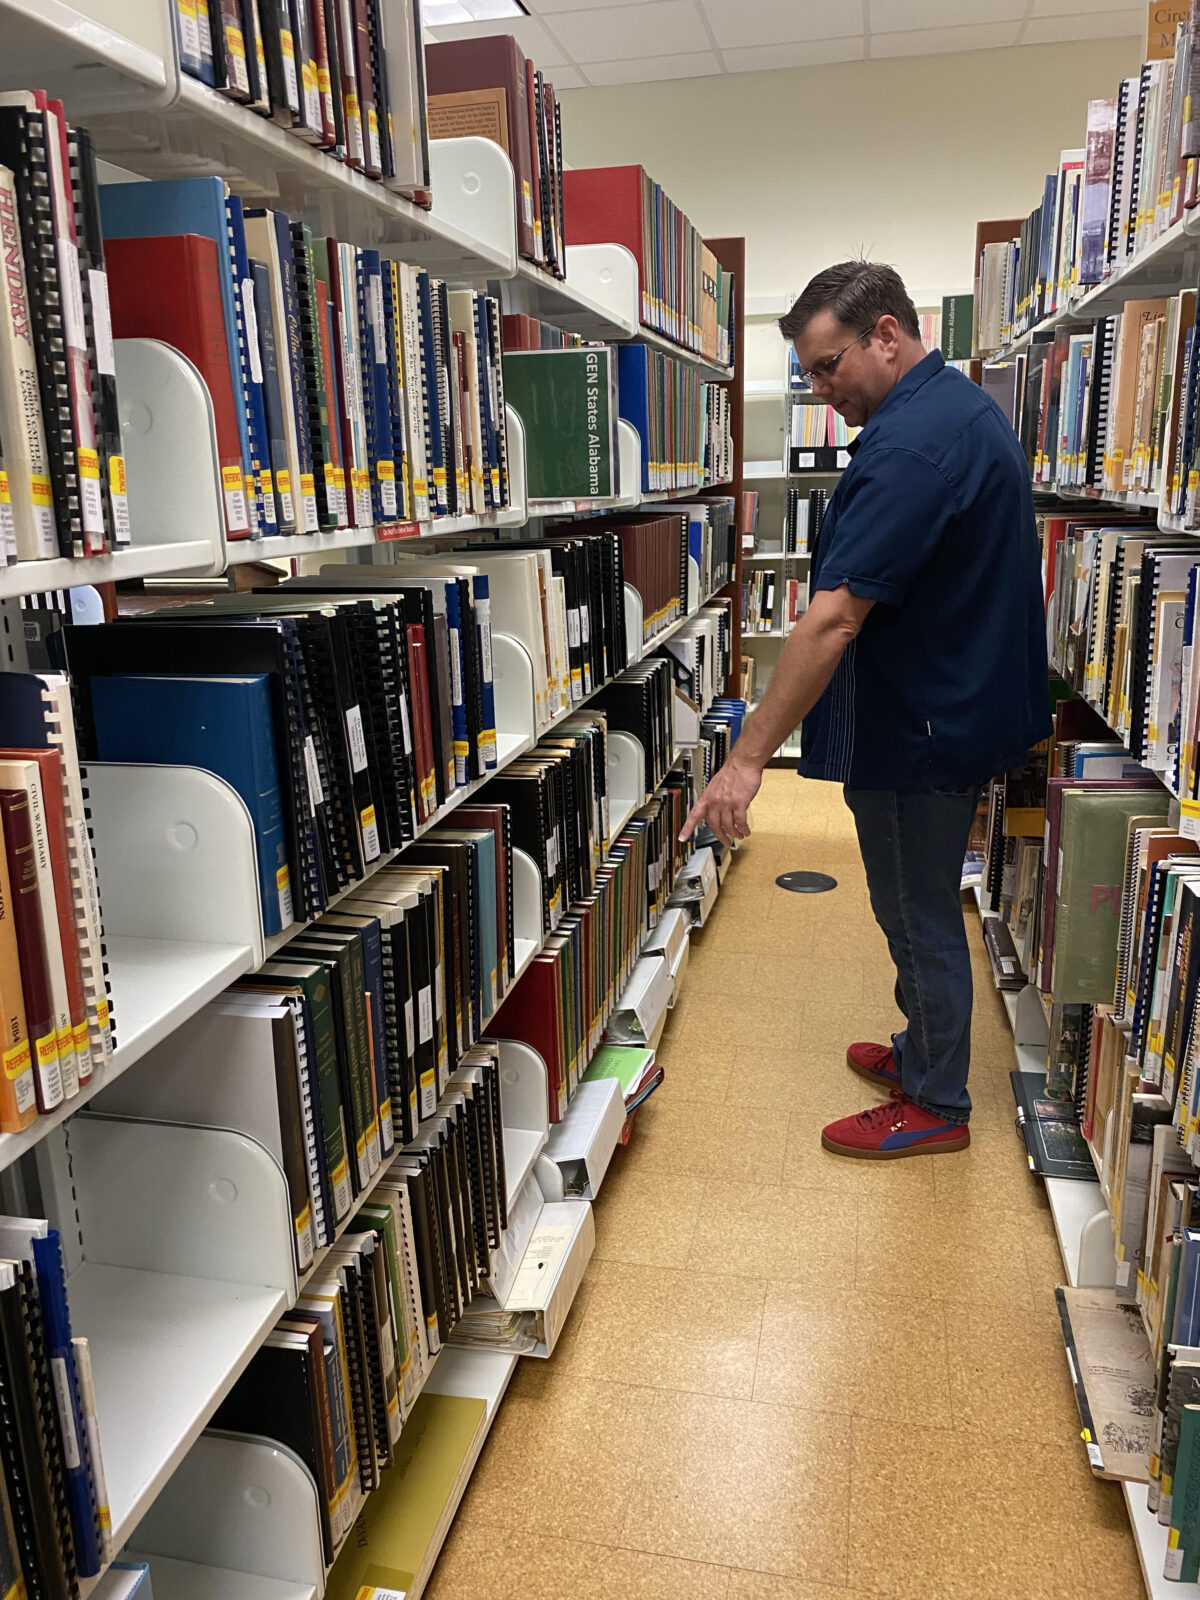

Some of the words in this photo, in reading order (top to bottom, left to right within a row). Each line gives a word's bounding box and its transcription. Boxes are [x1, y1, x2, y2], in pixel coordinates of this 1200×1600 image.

[0, 187, 31, 347] HENDRY
[948, 297, 956, 326] Alabama
[287, 314, 301, 361] Collins
[947, 327, 955, 359] Reference
[586, 353, 598, 382] GEN
[586, 384, 599, 430] States
[588, 431, 600, 495] Alabama
[30, 783, 40, 812] CIVIL
[35, 812, 43, 837] WAR
[38, 838, 48, 870] DIARY
